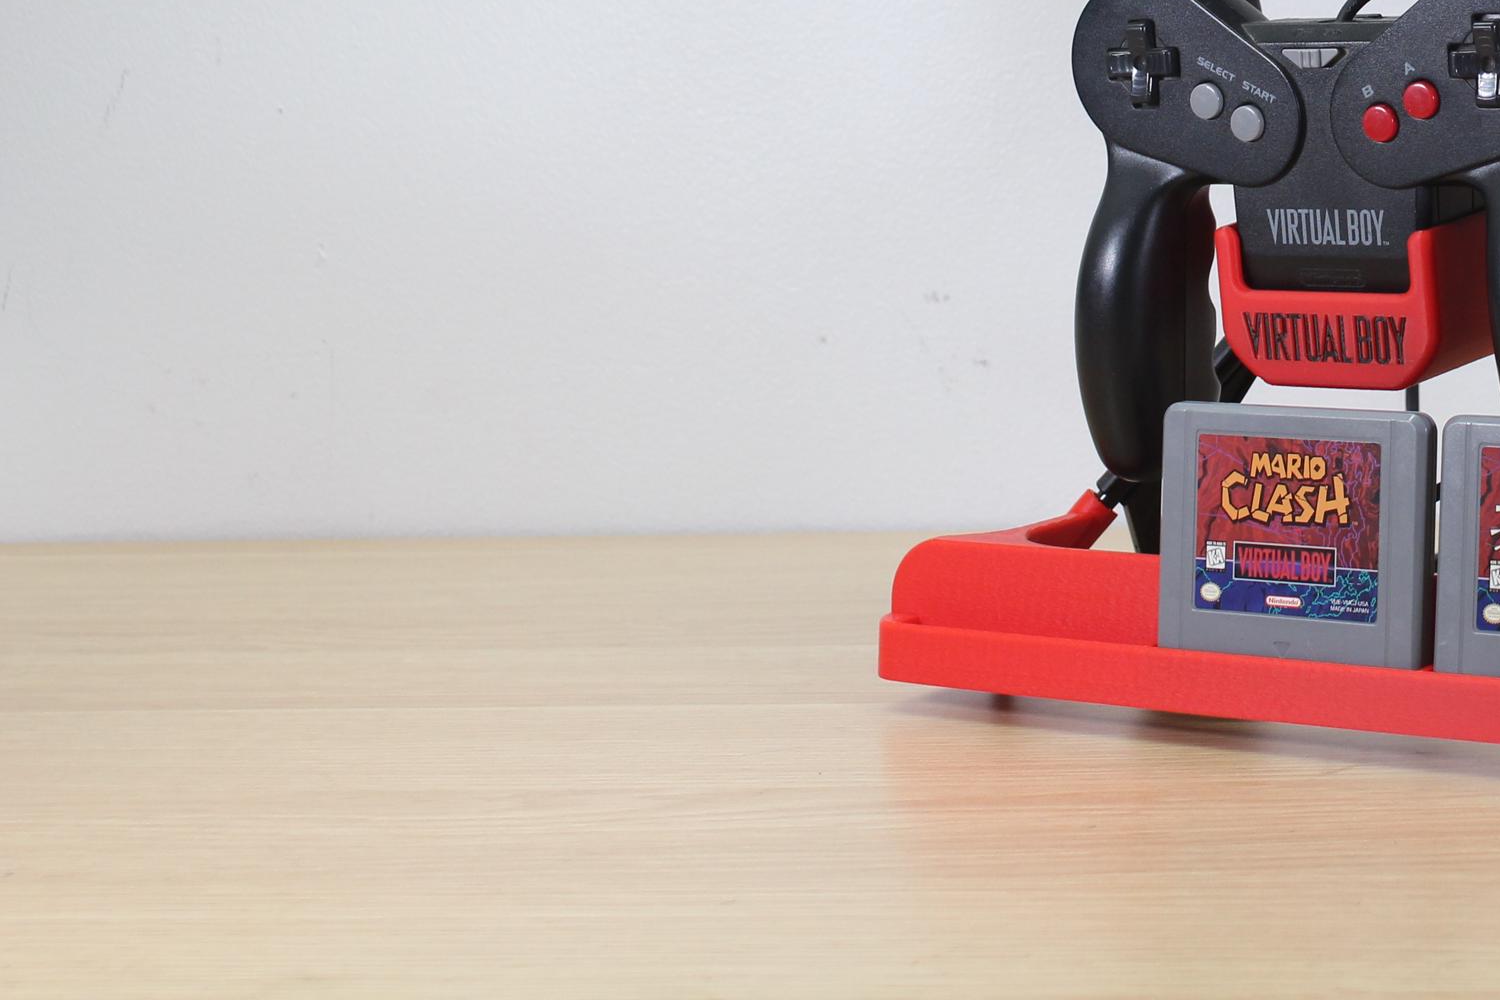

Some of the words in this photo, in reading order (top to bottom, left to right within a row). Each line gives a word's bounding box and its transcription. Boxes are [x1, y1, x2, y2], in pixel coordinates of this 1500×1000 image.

[1196, 56, 1236, 82] SELECT
[1404, 62, 1416, 76] A
[1241, 80, 1277, 104] START
[1361, 84, 1374, 98] B
[1266, 208, 1346, 246] VIRTUAL
[1346, 208, 1384, 247] BOY
[1243, 311, 1352, 363] VIRTUAL
[1353, 315, 1407, 365] BOY
[1250, 452, 1326, 481] MARIO
[1220, 470, 1351, 525] CLASH
[1238, 546, 1300, 580] VIRTUAL
[1300, 550, 1332, 583] BOY
[1268, 596, 1299, 607] Nintendo
